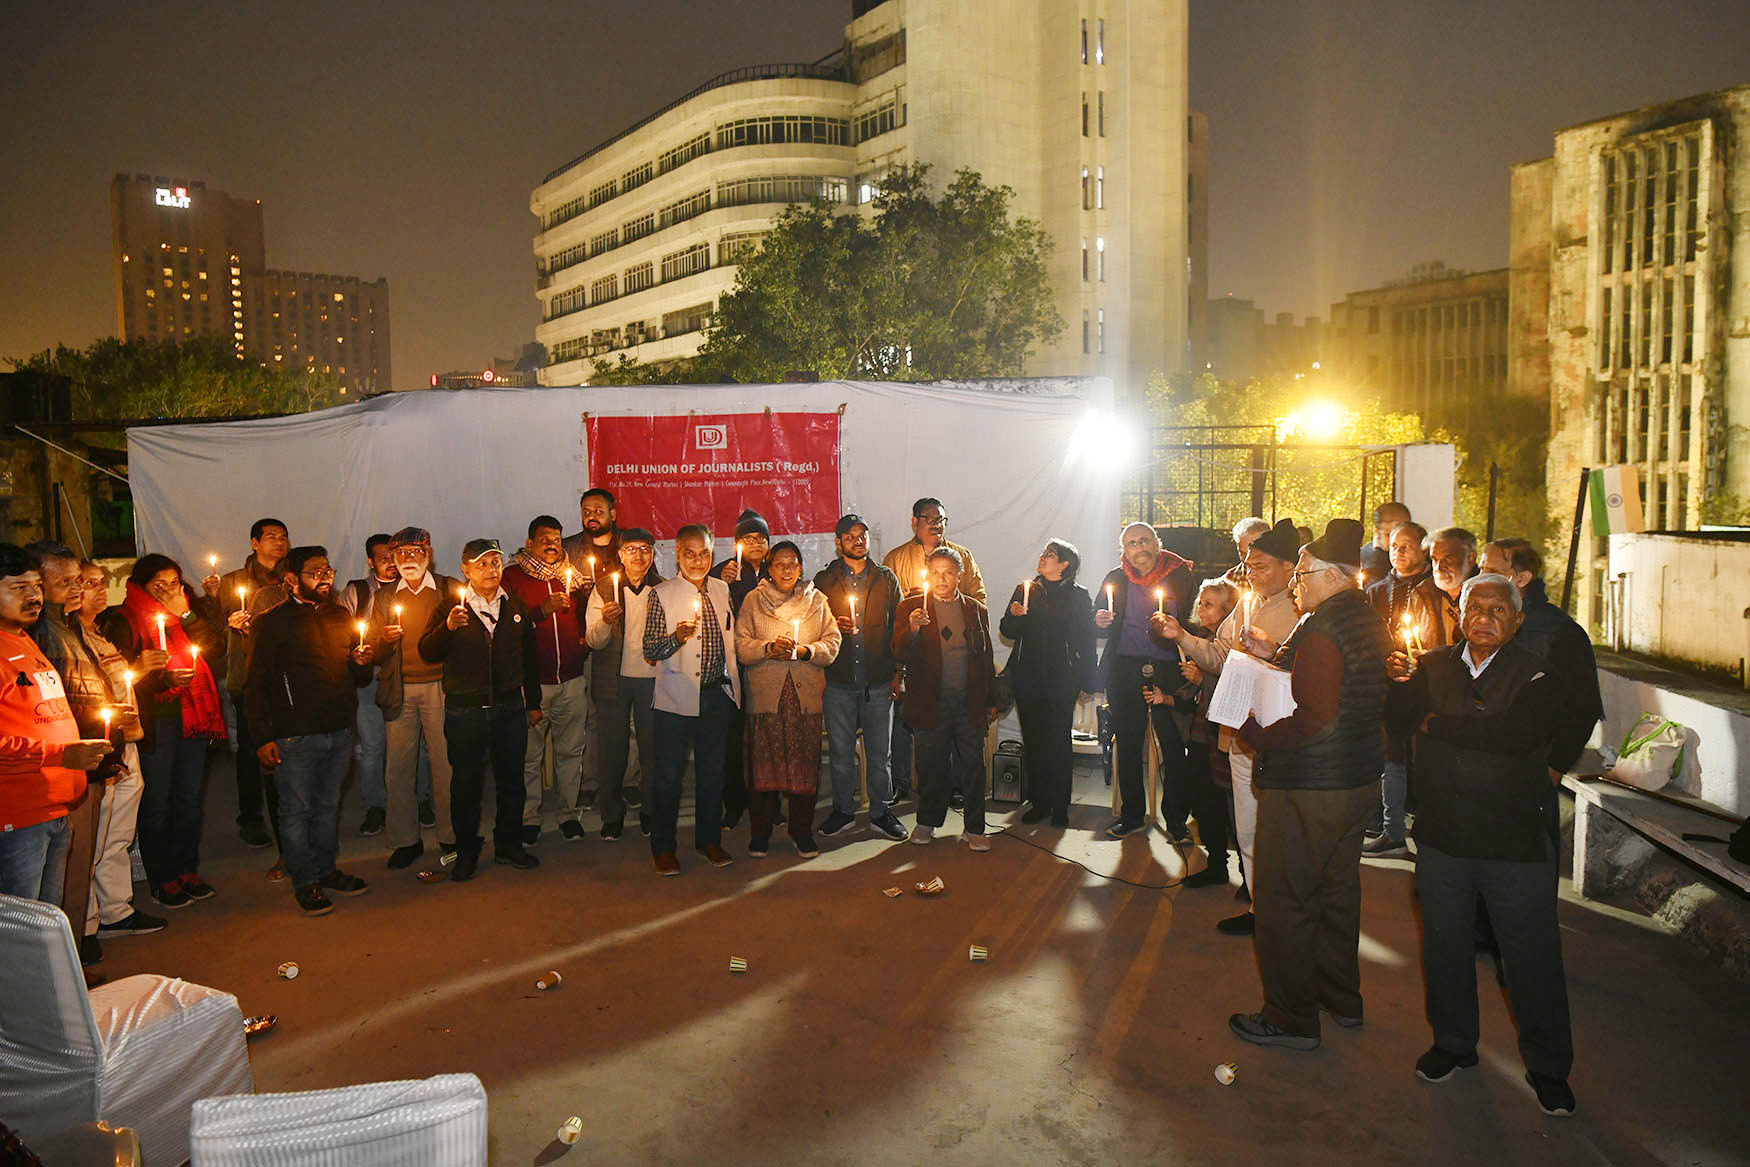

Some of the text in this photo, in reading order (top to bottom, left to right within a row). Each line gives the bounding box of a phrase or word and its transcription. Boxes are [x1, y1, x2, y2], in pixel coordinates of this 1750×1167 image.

[606, 463, 639, 474] DELHI
[641, 463, 678, 474] UNION
[680, 463, 696, 473] OF
[698, 461, 774, 473] JOURNALISTS
